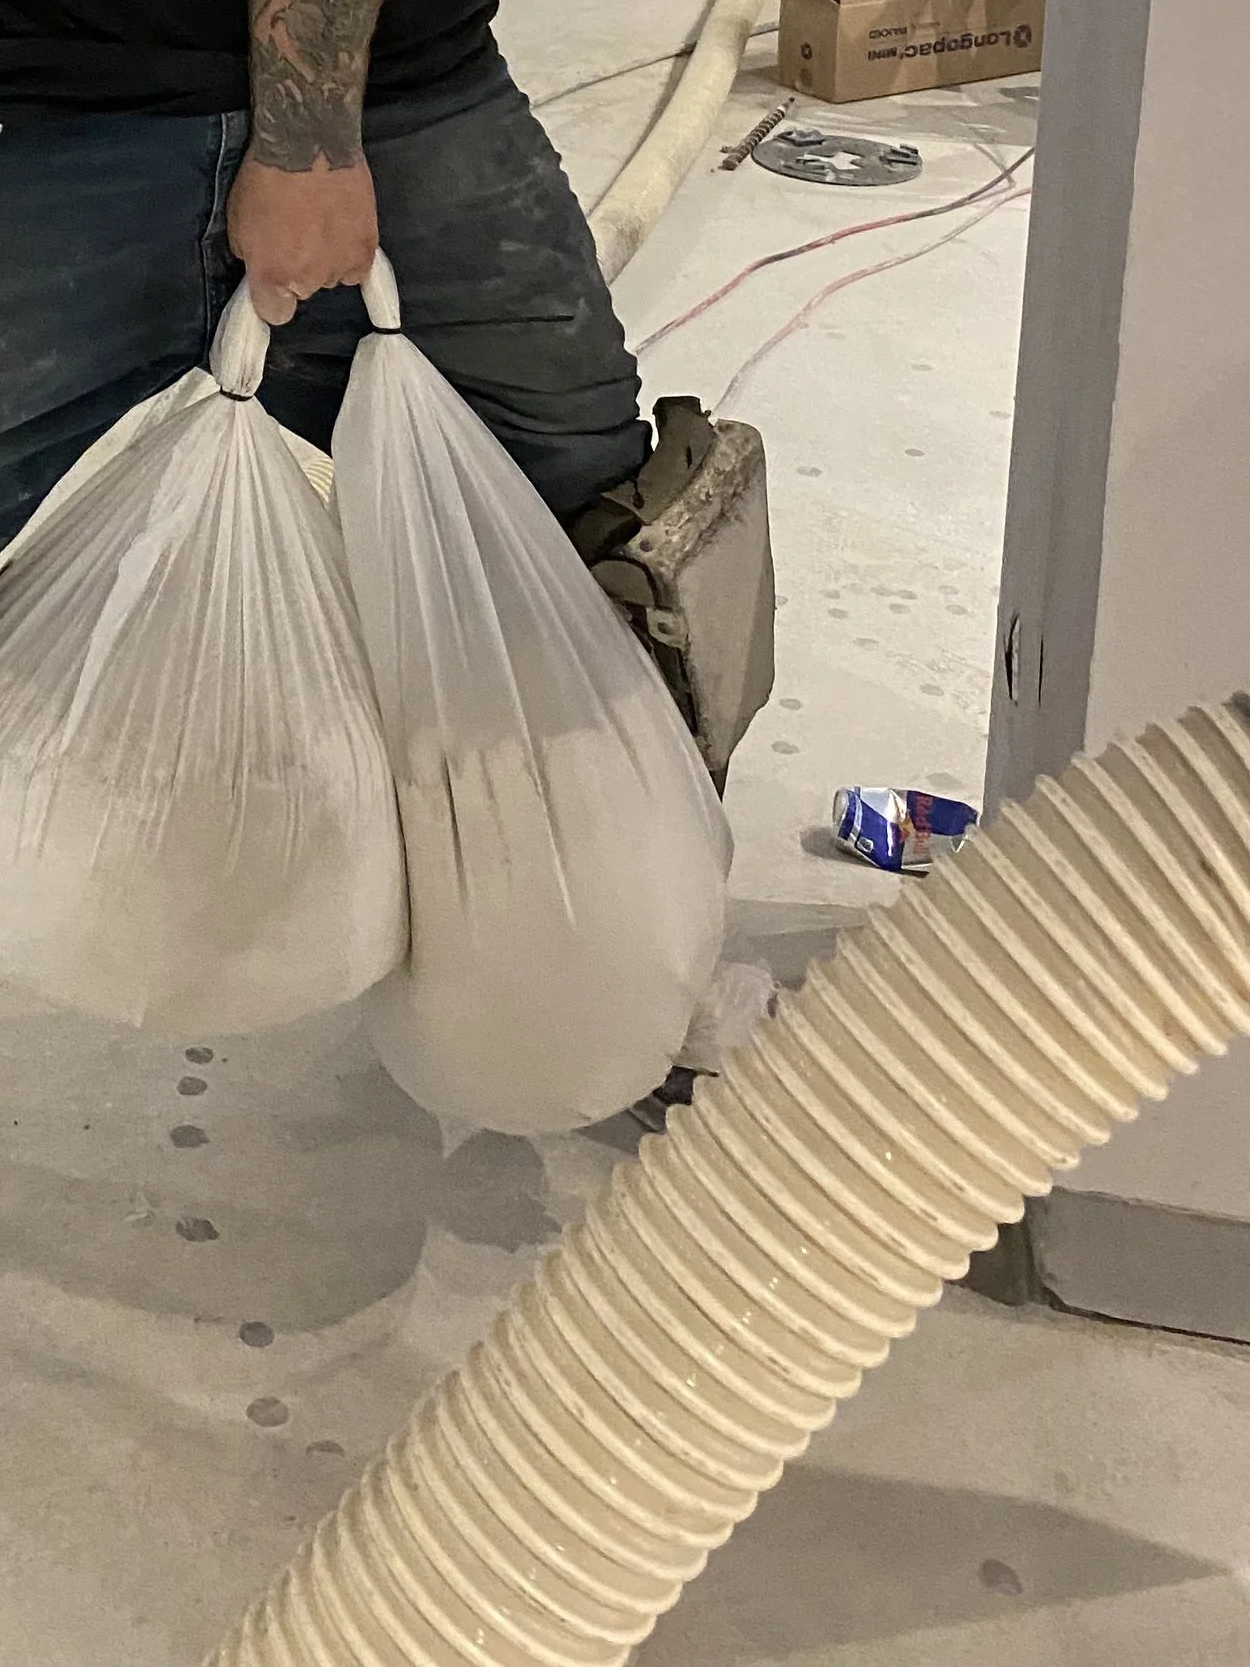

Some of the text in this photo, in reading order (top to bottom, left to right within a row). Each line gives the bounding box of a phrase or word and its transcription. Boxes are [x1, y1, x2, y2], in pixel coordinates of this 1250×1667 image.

[867, 30, 1012, 61] Longopac MINI
[916, 795, 934, 828] Red
